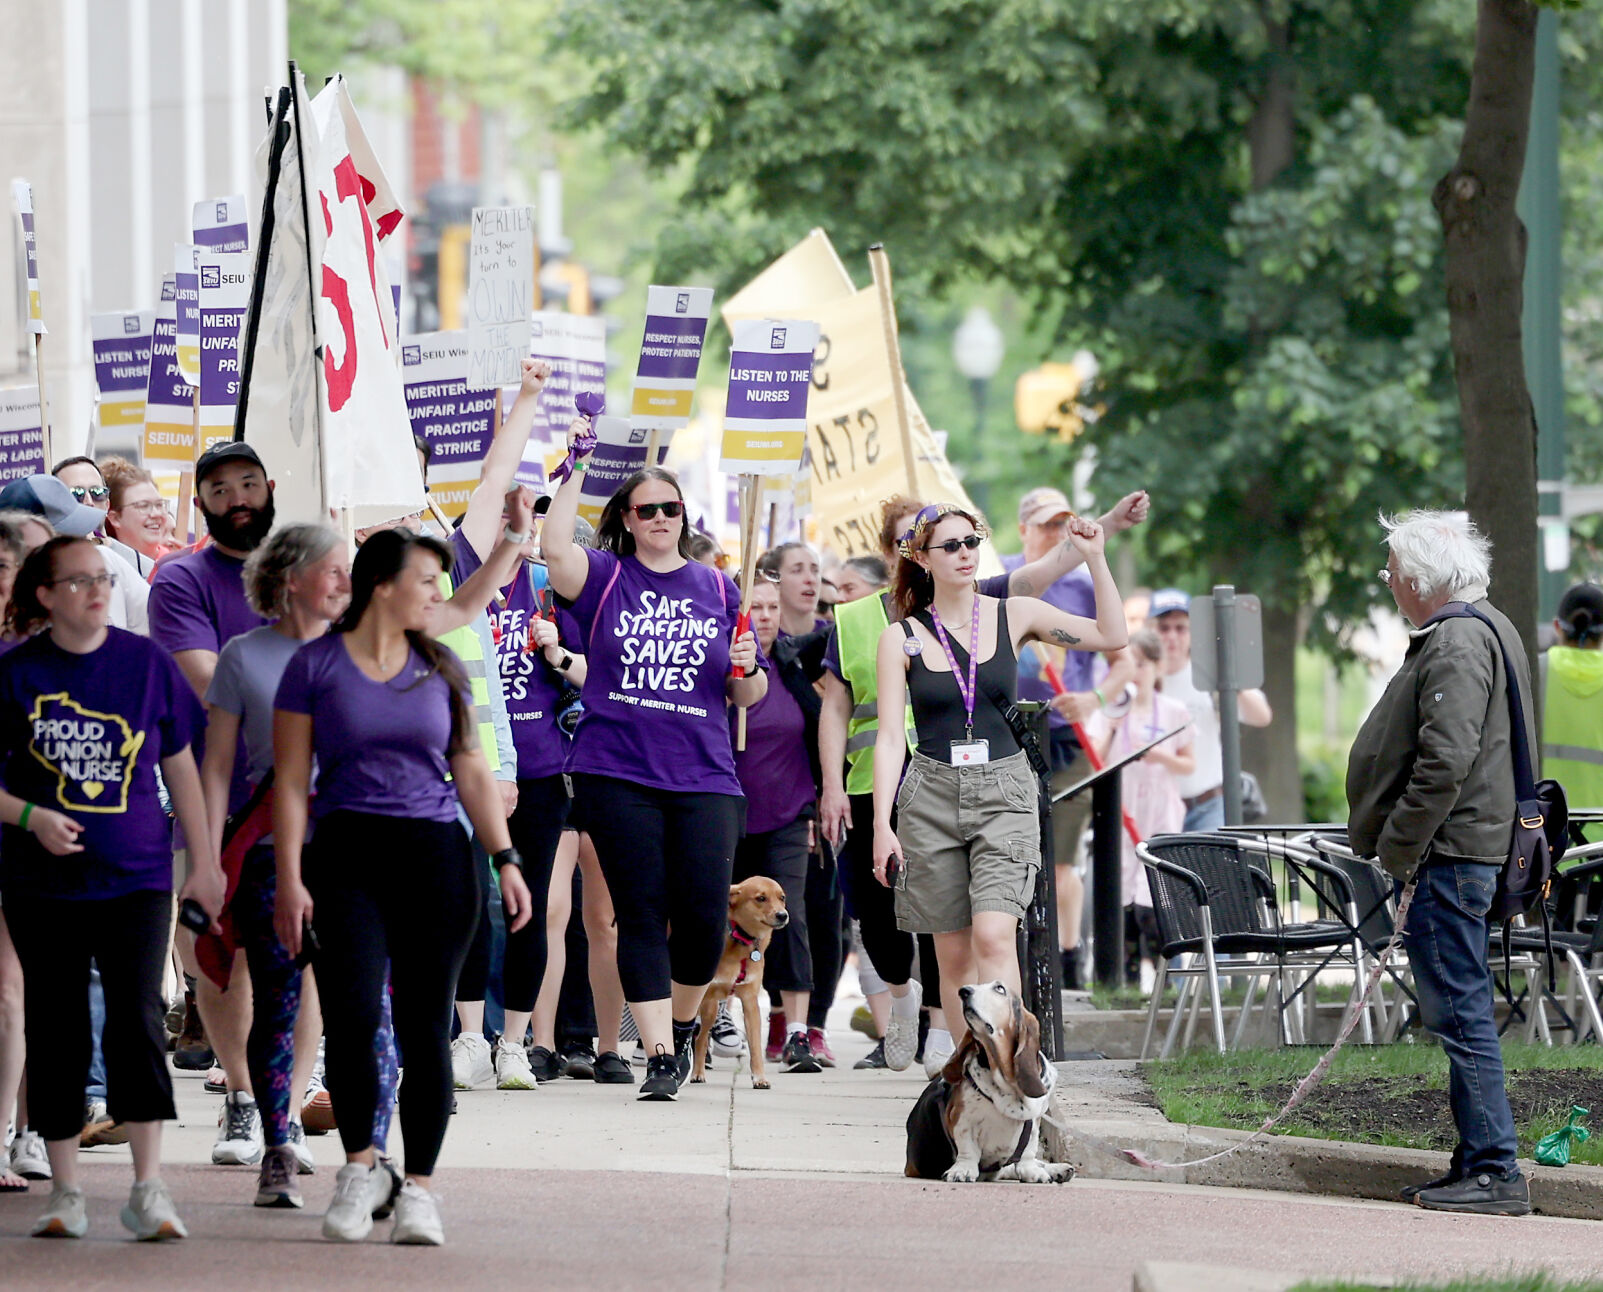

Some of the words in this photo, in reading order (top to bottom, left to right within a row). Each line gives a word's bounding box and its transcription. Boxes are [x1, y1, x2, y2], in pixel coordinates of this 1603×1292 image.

[473, 207, 532, 237] MERITER
[480, 262, 500, 273] turn
[508, 255, 517, 269] to
[222, 274, 245, 284] SEIU
[474, 278, 527, 322] OWN
[486, 327, 510, 346] THE
[645, 332, 677, 345] RESPECT
[95, 351, 133, 364] LISTEN
[135, 349, 151, 361] TO
[422, 349, 448, 359] SEIU
[641, 347, 673, 358] PROTECT
[673, 349, 701, 359] PATIENTS
[731, 368, 772, 383] LISTEN
[775, 370, 788, 382] TO
[789, 369, 810, 382] THE
[406, 381, 466, 400] MERITER
[746, 389, 790, 402] NURSES
[407, 403, 457, 420] UNFAIR
[424, 420, 489, 438] PRACTICE
[434, 440, 482, 456] STRIKE
[614, 610, 719, 639] STAFFING
[620, 638, 709, 665] SAVES
[620, 666, 698, 692] LIVES
[608, 692, 639, 706] SUPPORT
[640, 699, 675, 713] MERITER
[677, 705, 708, 718] NURSES
[513, 710, 543, 721] NURSES
[34, 719, 105, 741] PROUD
[43, 741, 112, 760] UNION
[61, 760, 123, 782] NURSE
